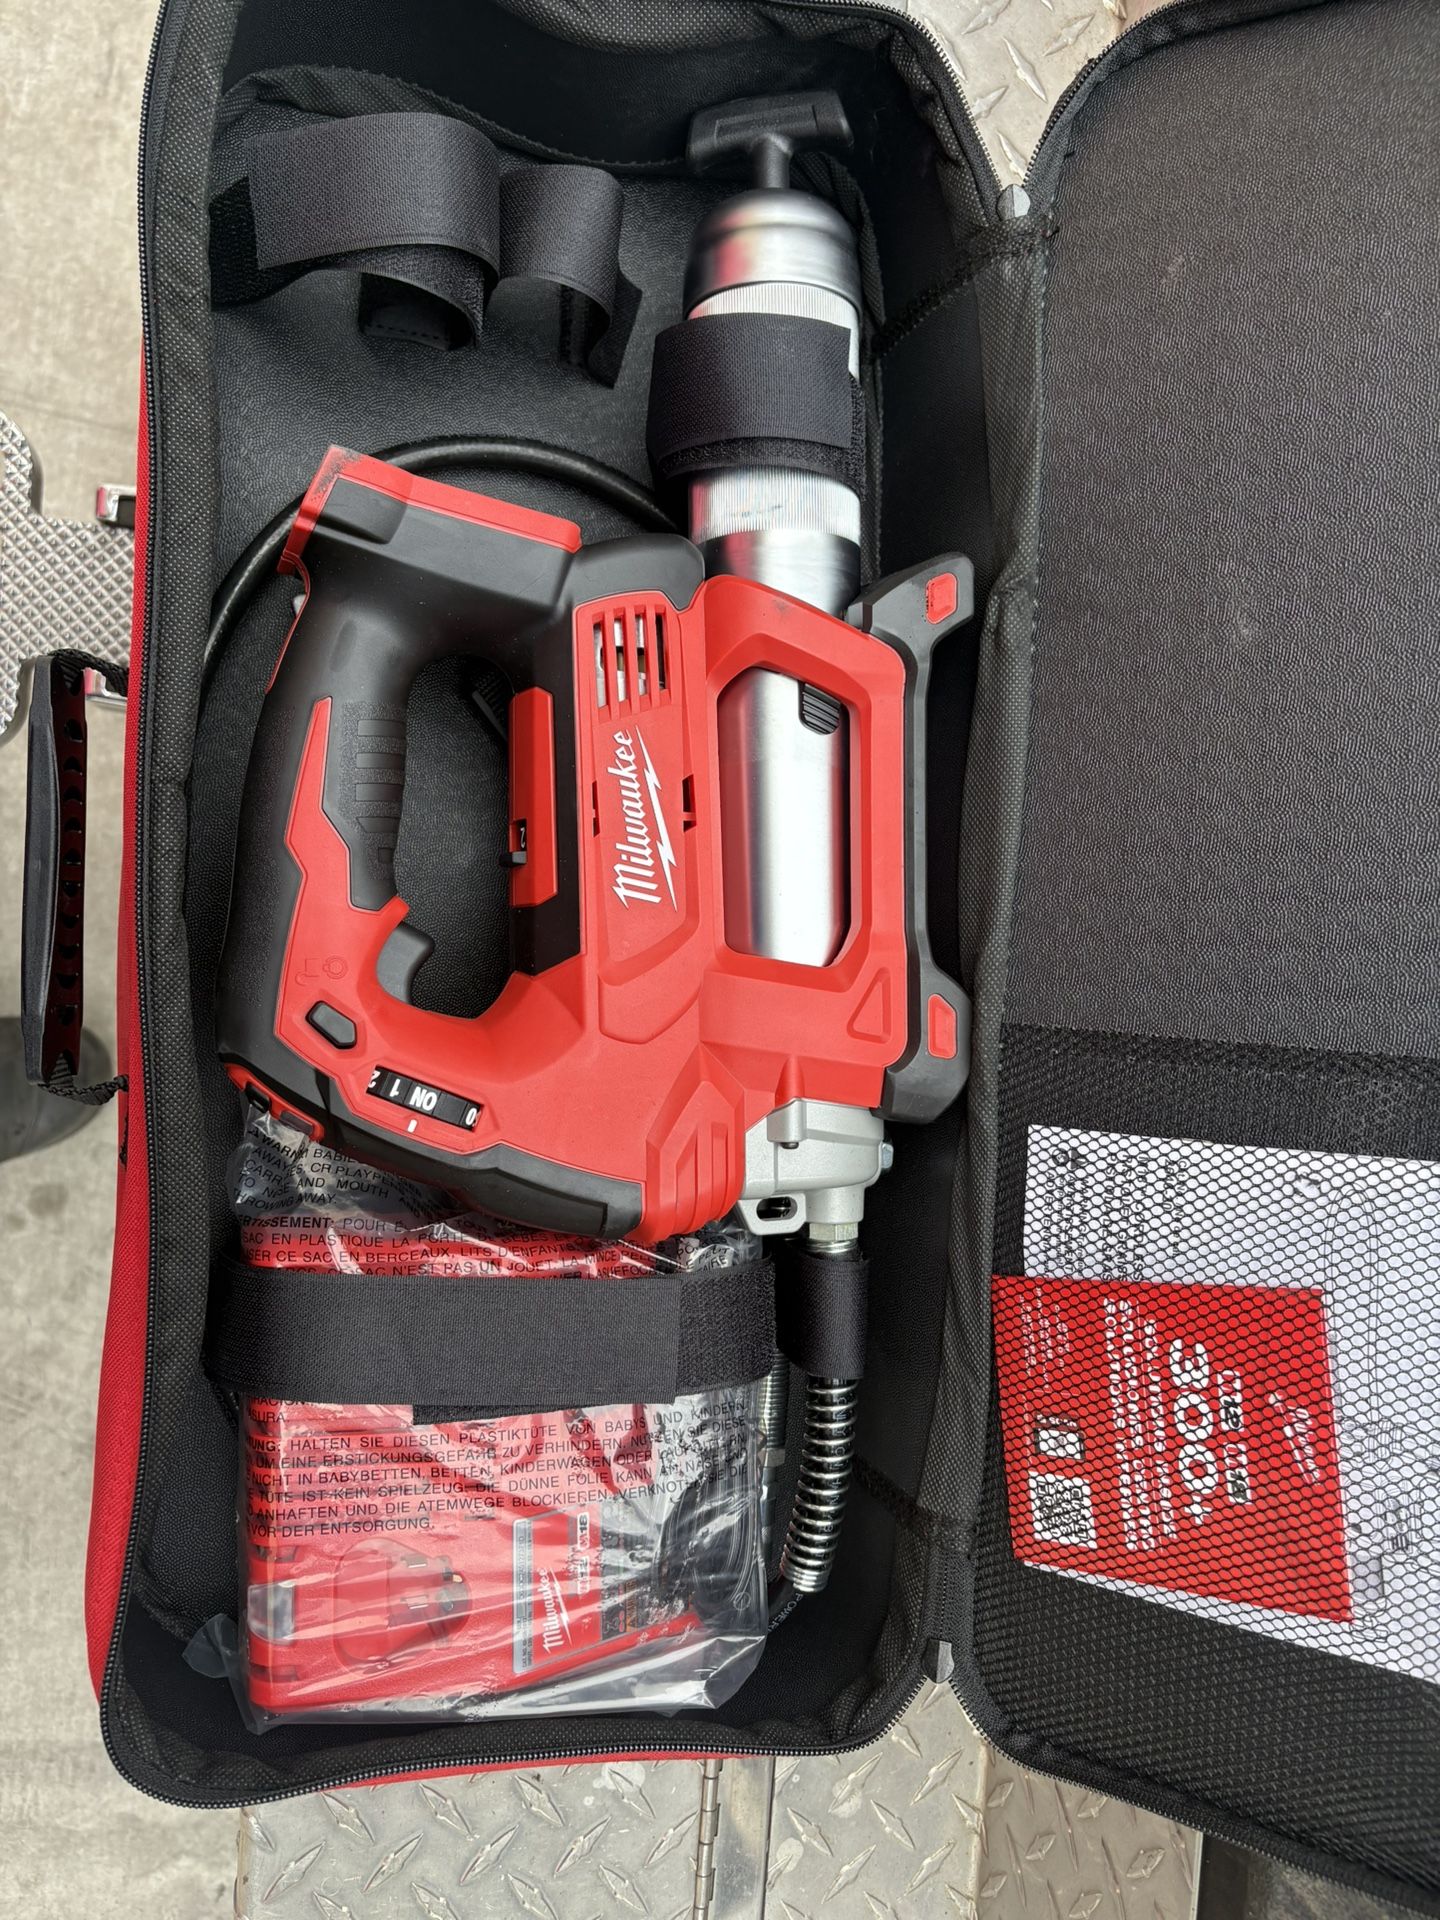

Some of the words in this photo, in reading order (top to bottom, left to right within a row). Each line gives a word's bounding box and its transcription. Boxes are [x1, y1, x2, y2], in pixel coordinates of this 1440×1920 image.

[606, 729, 662, 908] Milwaukee
[389, 1079, 401, 1097] 1
[409, 1086, 438, 1111] ON
[296, 1178, 325, 1189] AND
[336, 1179, 389, 1198] MOUTH
[271, 1233, 292, 1245] EN
[300, 1233, 384, 1248] PLASTIQUE
[392, 1238, 410, 1249] LA
[276, 1251, 297, 1262] CE
[303, 1251, 333, 1263] SAC
[340, 1251, 360, 1262] EN
[366, 1247, 455, 1263] BERCEAUX,
[460, 1248, 492, 1258] LITS
[393, 1264, 435, 1276] N'EST
[444, 1262, 473, 1274] PAS
[480, 1261, 500, 1273] UN
[563, 1257, 578, 1267] LA
[585, 1250, 617, 1264] MINCE
[256, 1457, 276, 1469] UM
[503, 1447, 520, 1458] ZU
[525, 1439, 626, 1456] VERHINDERN.
[712, 1415, 746, 1433] DIESE
[290, 1437, 350, 1451] HALTEN
[360, 1436, 384, 1448] SIE
[393, 1433, 450, 1448] DIESEN
[459, 1424, 557, 1443] PLASTIKTÜTE
[566, 1422, 596, 1435] VON
[605, 1416, 646, 1433] BABYS
[653, 1411, 683, 1425] UND
[1170, 1339, 1220, 1525] 300+
[298, 1473, 312, 1485] IN
[319, 1467, 426, 1484] BABYBETTEN,
[431, 1465, 495, 1479] BETTEN,
[500, 1455, 612, 1475] KINDERWAGEN
[616, 1450, 652, 1466] ODER
[260, 1490, 293, 1503] TÜTE
[302, 1489, 326, 1502] IST
[334, 1486, 370, 1499] KEIN
[476, 1484, 500, 1494] DIE
[509, 1475, 560, 1492] DÜNNE
[567, 1472, 609, 1487] FOLIE
[616, 1468, 652, 1483] KANN
[256, 1506, 338, 1520] ANHAFTEN
[346, 1504, 378, 1516] UND
[386, 1501, 410, 1514] DIE
[417, 1497, 504, 1512] ATEMWEGE
[251, 1525, 276, 1538] VOR
[282, 1525, 314, 1538] DER
[320, 1518, 435, 1535] ENTSORGUNG.
[578, 1514, 589, 1548] M18
[537, 1568, 564, 1654] Milwaukee
